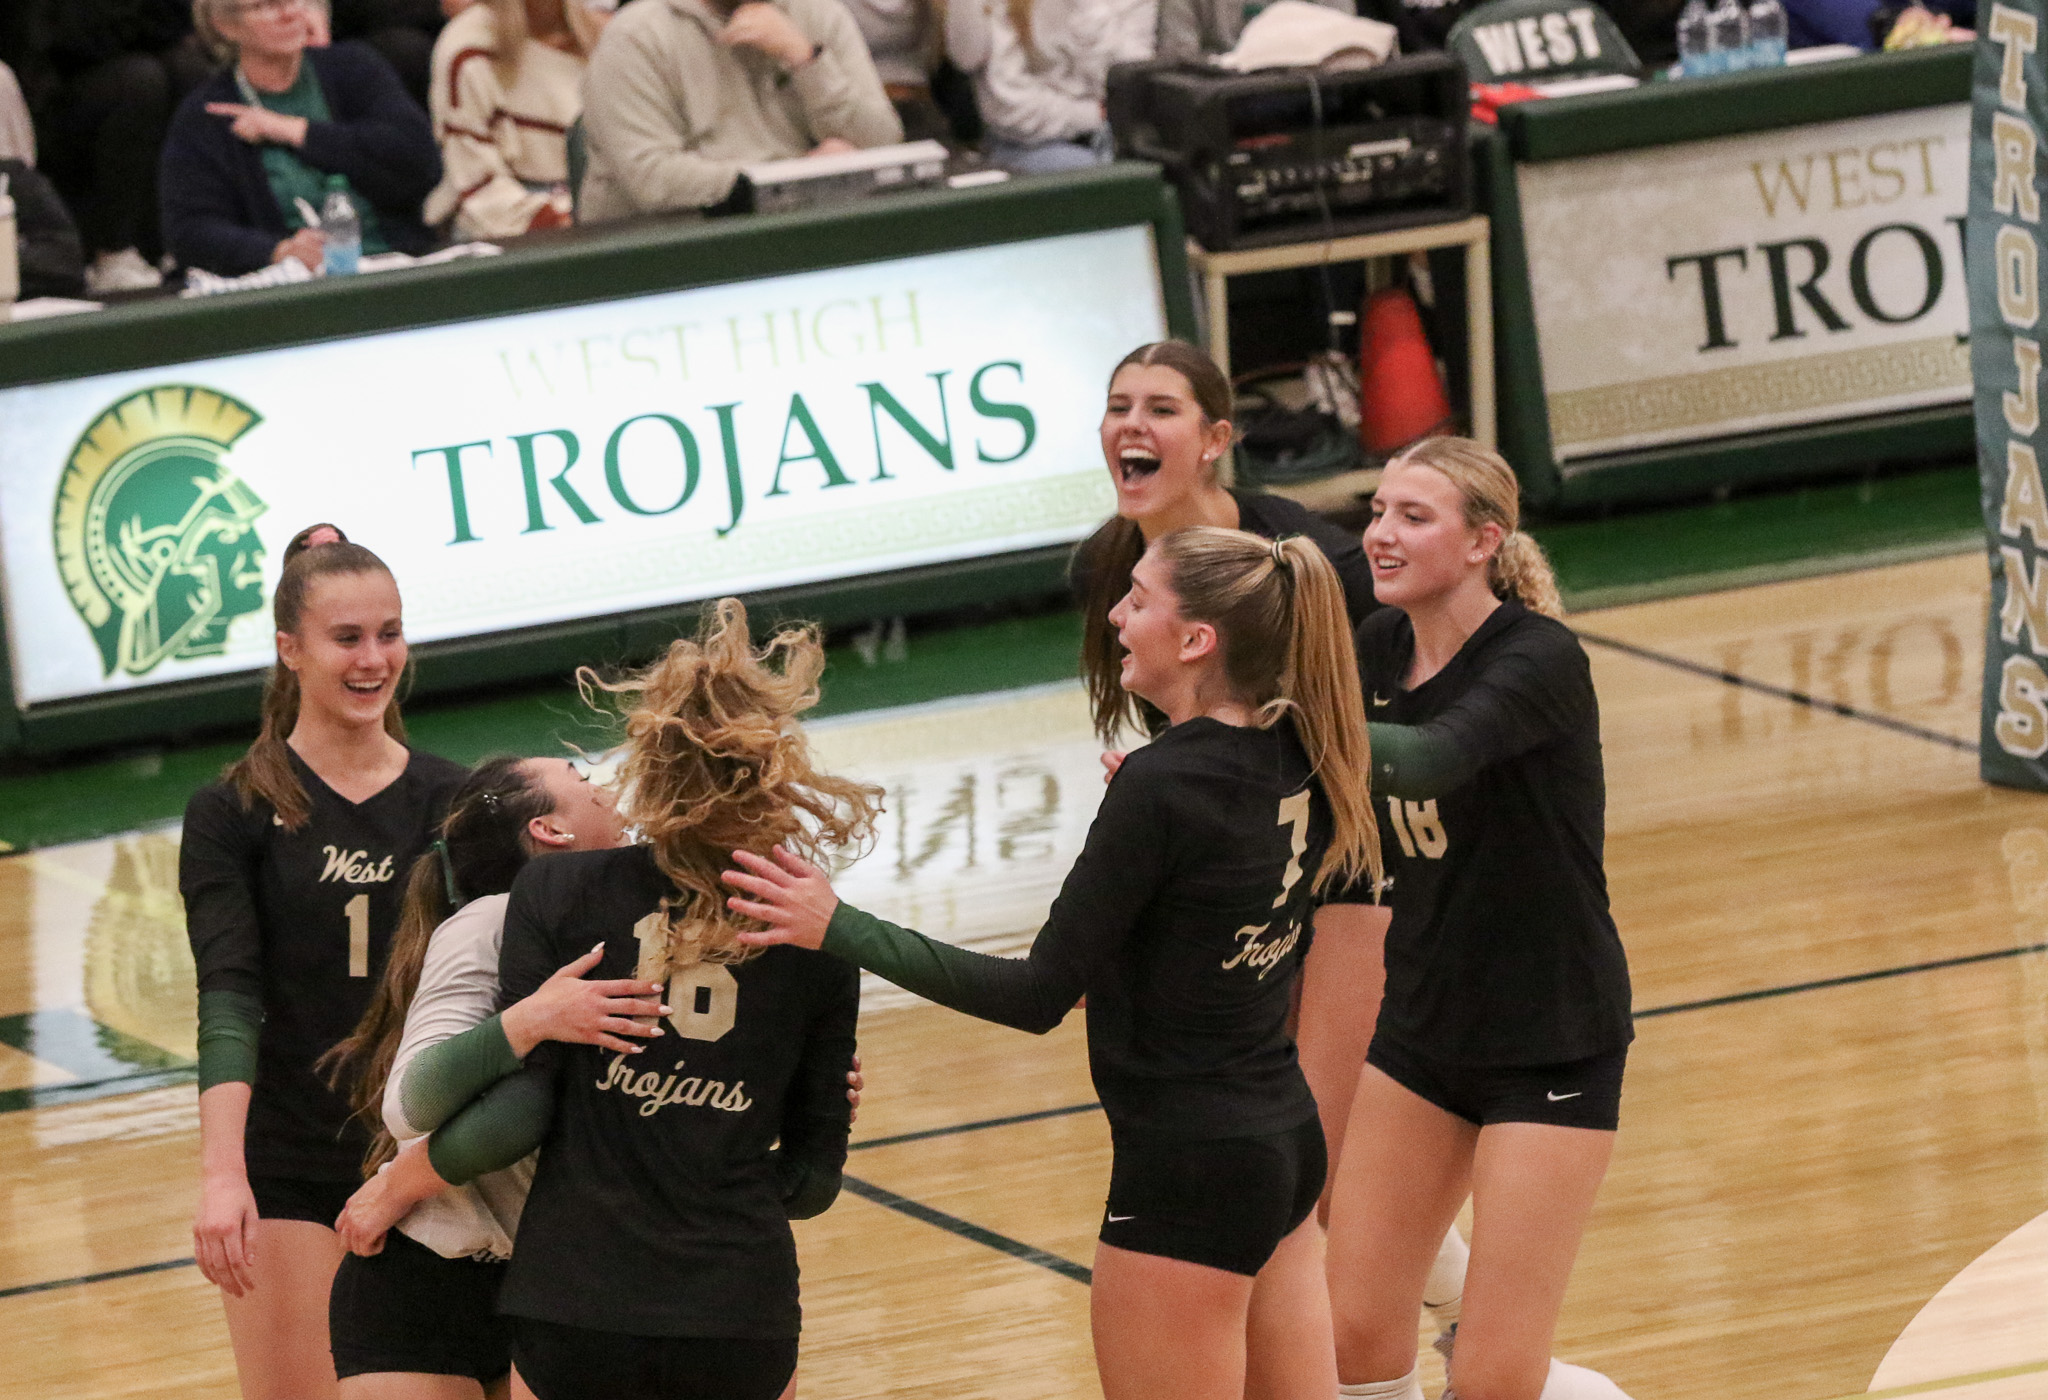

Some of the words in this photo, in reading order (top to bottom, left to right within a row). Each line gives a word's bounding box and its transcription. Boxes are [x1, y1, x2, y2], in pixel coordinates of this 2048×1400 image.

[1472, 7, 1600, 75] WEST
[1752, 136, 1945, 217] WEST
[498, 322, 701, 398] WEST
[726, 289, 924, 371] HIGH
[1989, 2, 2048, 760] TROJANS
[411, 359, 1037, 546] TROJANS
[319, 845, 394, 883] West
[344, 894, 369, 977] 1
[596, 1045, 752, 1117] Trojans
